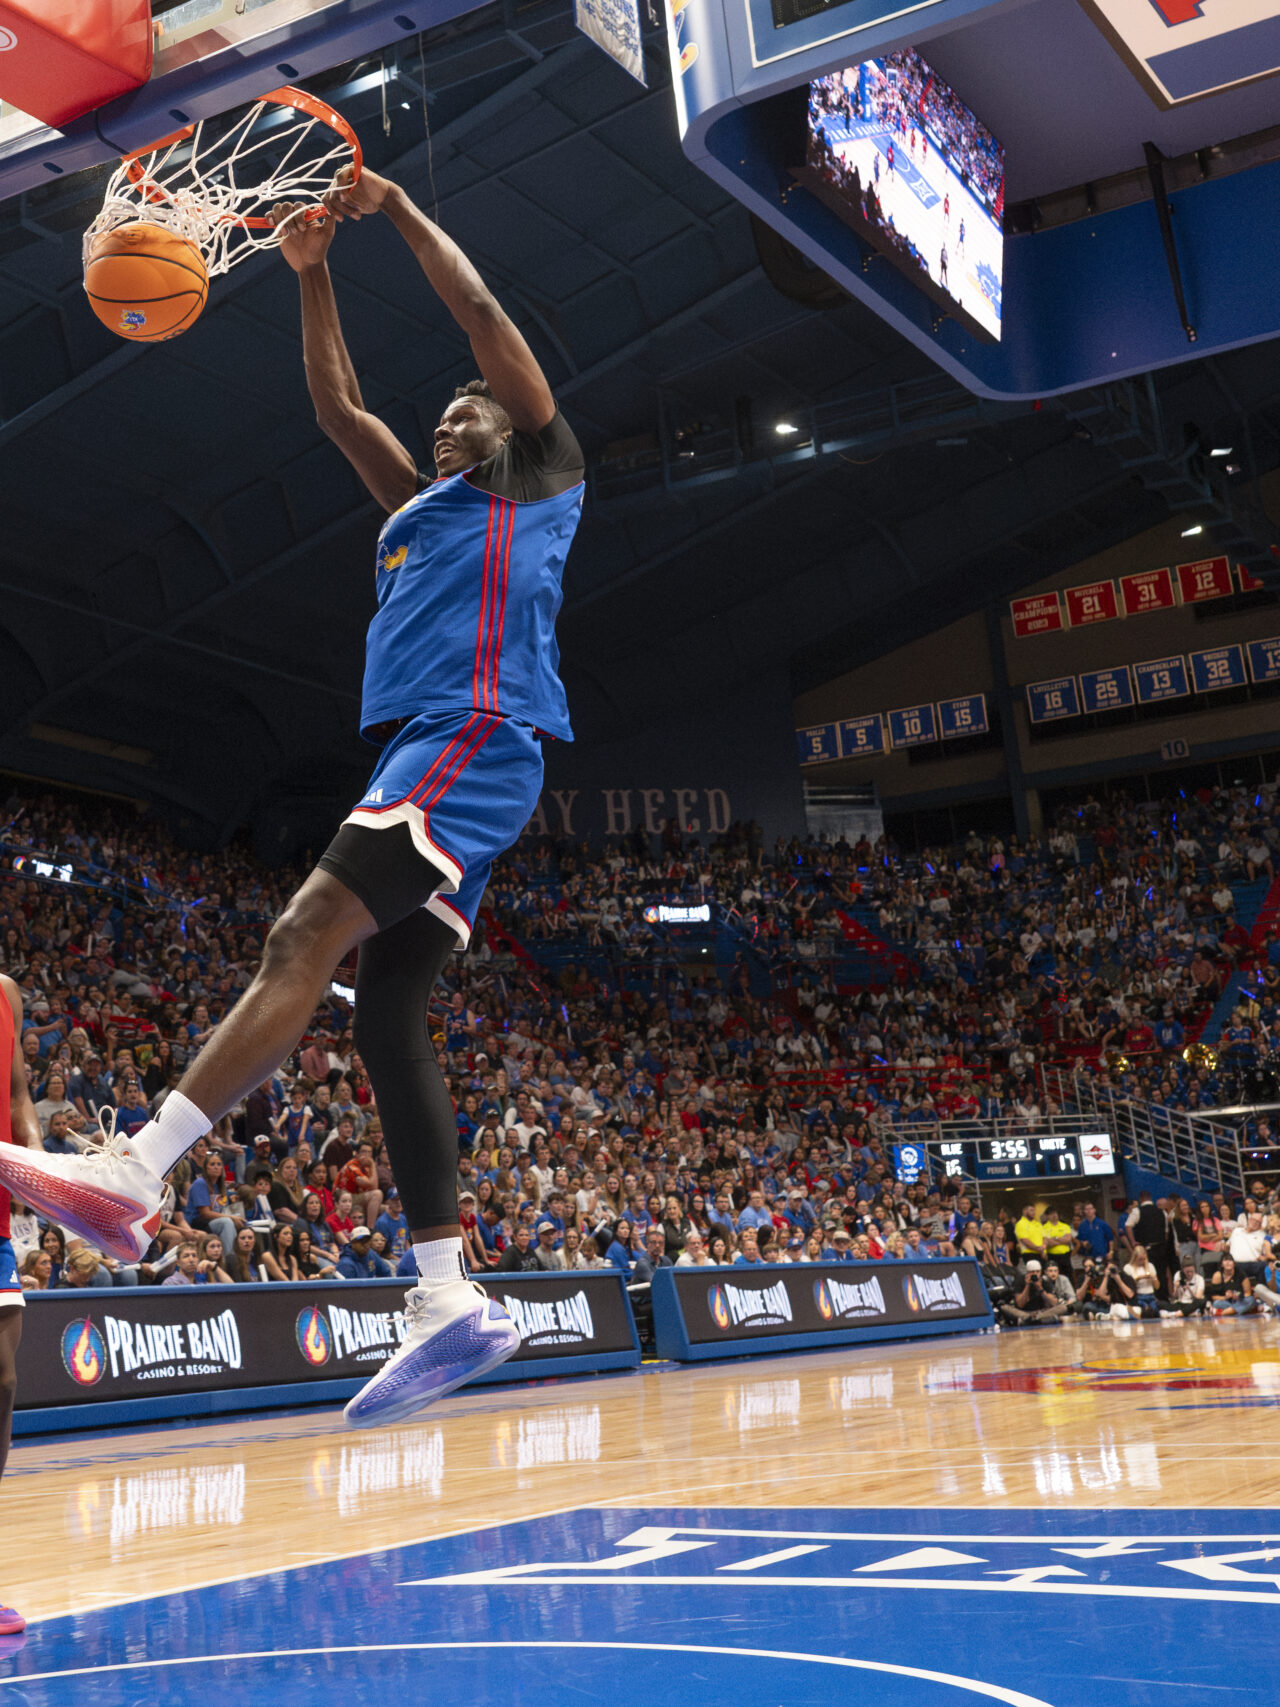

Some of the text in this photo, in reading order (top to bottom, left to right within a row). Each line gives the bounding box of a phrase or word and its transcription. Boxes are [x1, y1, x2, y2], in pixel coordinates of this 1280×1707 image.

[1194, 571, 1215, 591] 12
[1137, 583, 1158, 602] 31
[1014, 605, 1058, 621] CHAMPIONS
[1081, 596, 1101, 614] 21
[1138, 660, 1181, 674] CHAMBERLAIN
[1206, 659, 1230, 679] 32
[1095, 680, 1118, 700] 25
[1152, 670, 1171, 690] 13
[1044, 691, 1063, 710] 16
[903, 718, 922, 736] 10
[954, 708, 972, 727] 15
[811, 736, 822, 753] 5
[855, 728, 867, 745] 5
[1164, 741, 1186, 757] 10
[521, 788, 732, 836] AY HEED
[941, 1138, 1067, 1160] BLUE 3:55 WHITE
[1014, 1163, 1021, 1175] 1
[1059, 1153, 1076, 1171] 17
[826, 1275, 886, 1317] PRAIRIE BAND
[913, 1271, 966, 1310] PRAIRIE BAND
[724, 1279, 793, 1325] PRAIRIE BAND
[504, 1290, 594, 1340] PRAIRIE BAND
[328, 1304, 395, 1360] PRAIRIE
[104, 1309, 242, 1378] PRAIRIE BAND
[356, 1350, 386, 1361] CASINO
[136, 1364, 223, 1380] CASINO & RESORT
